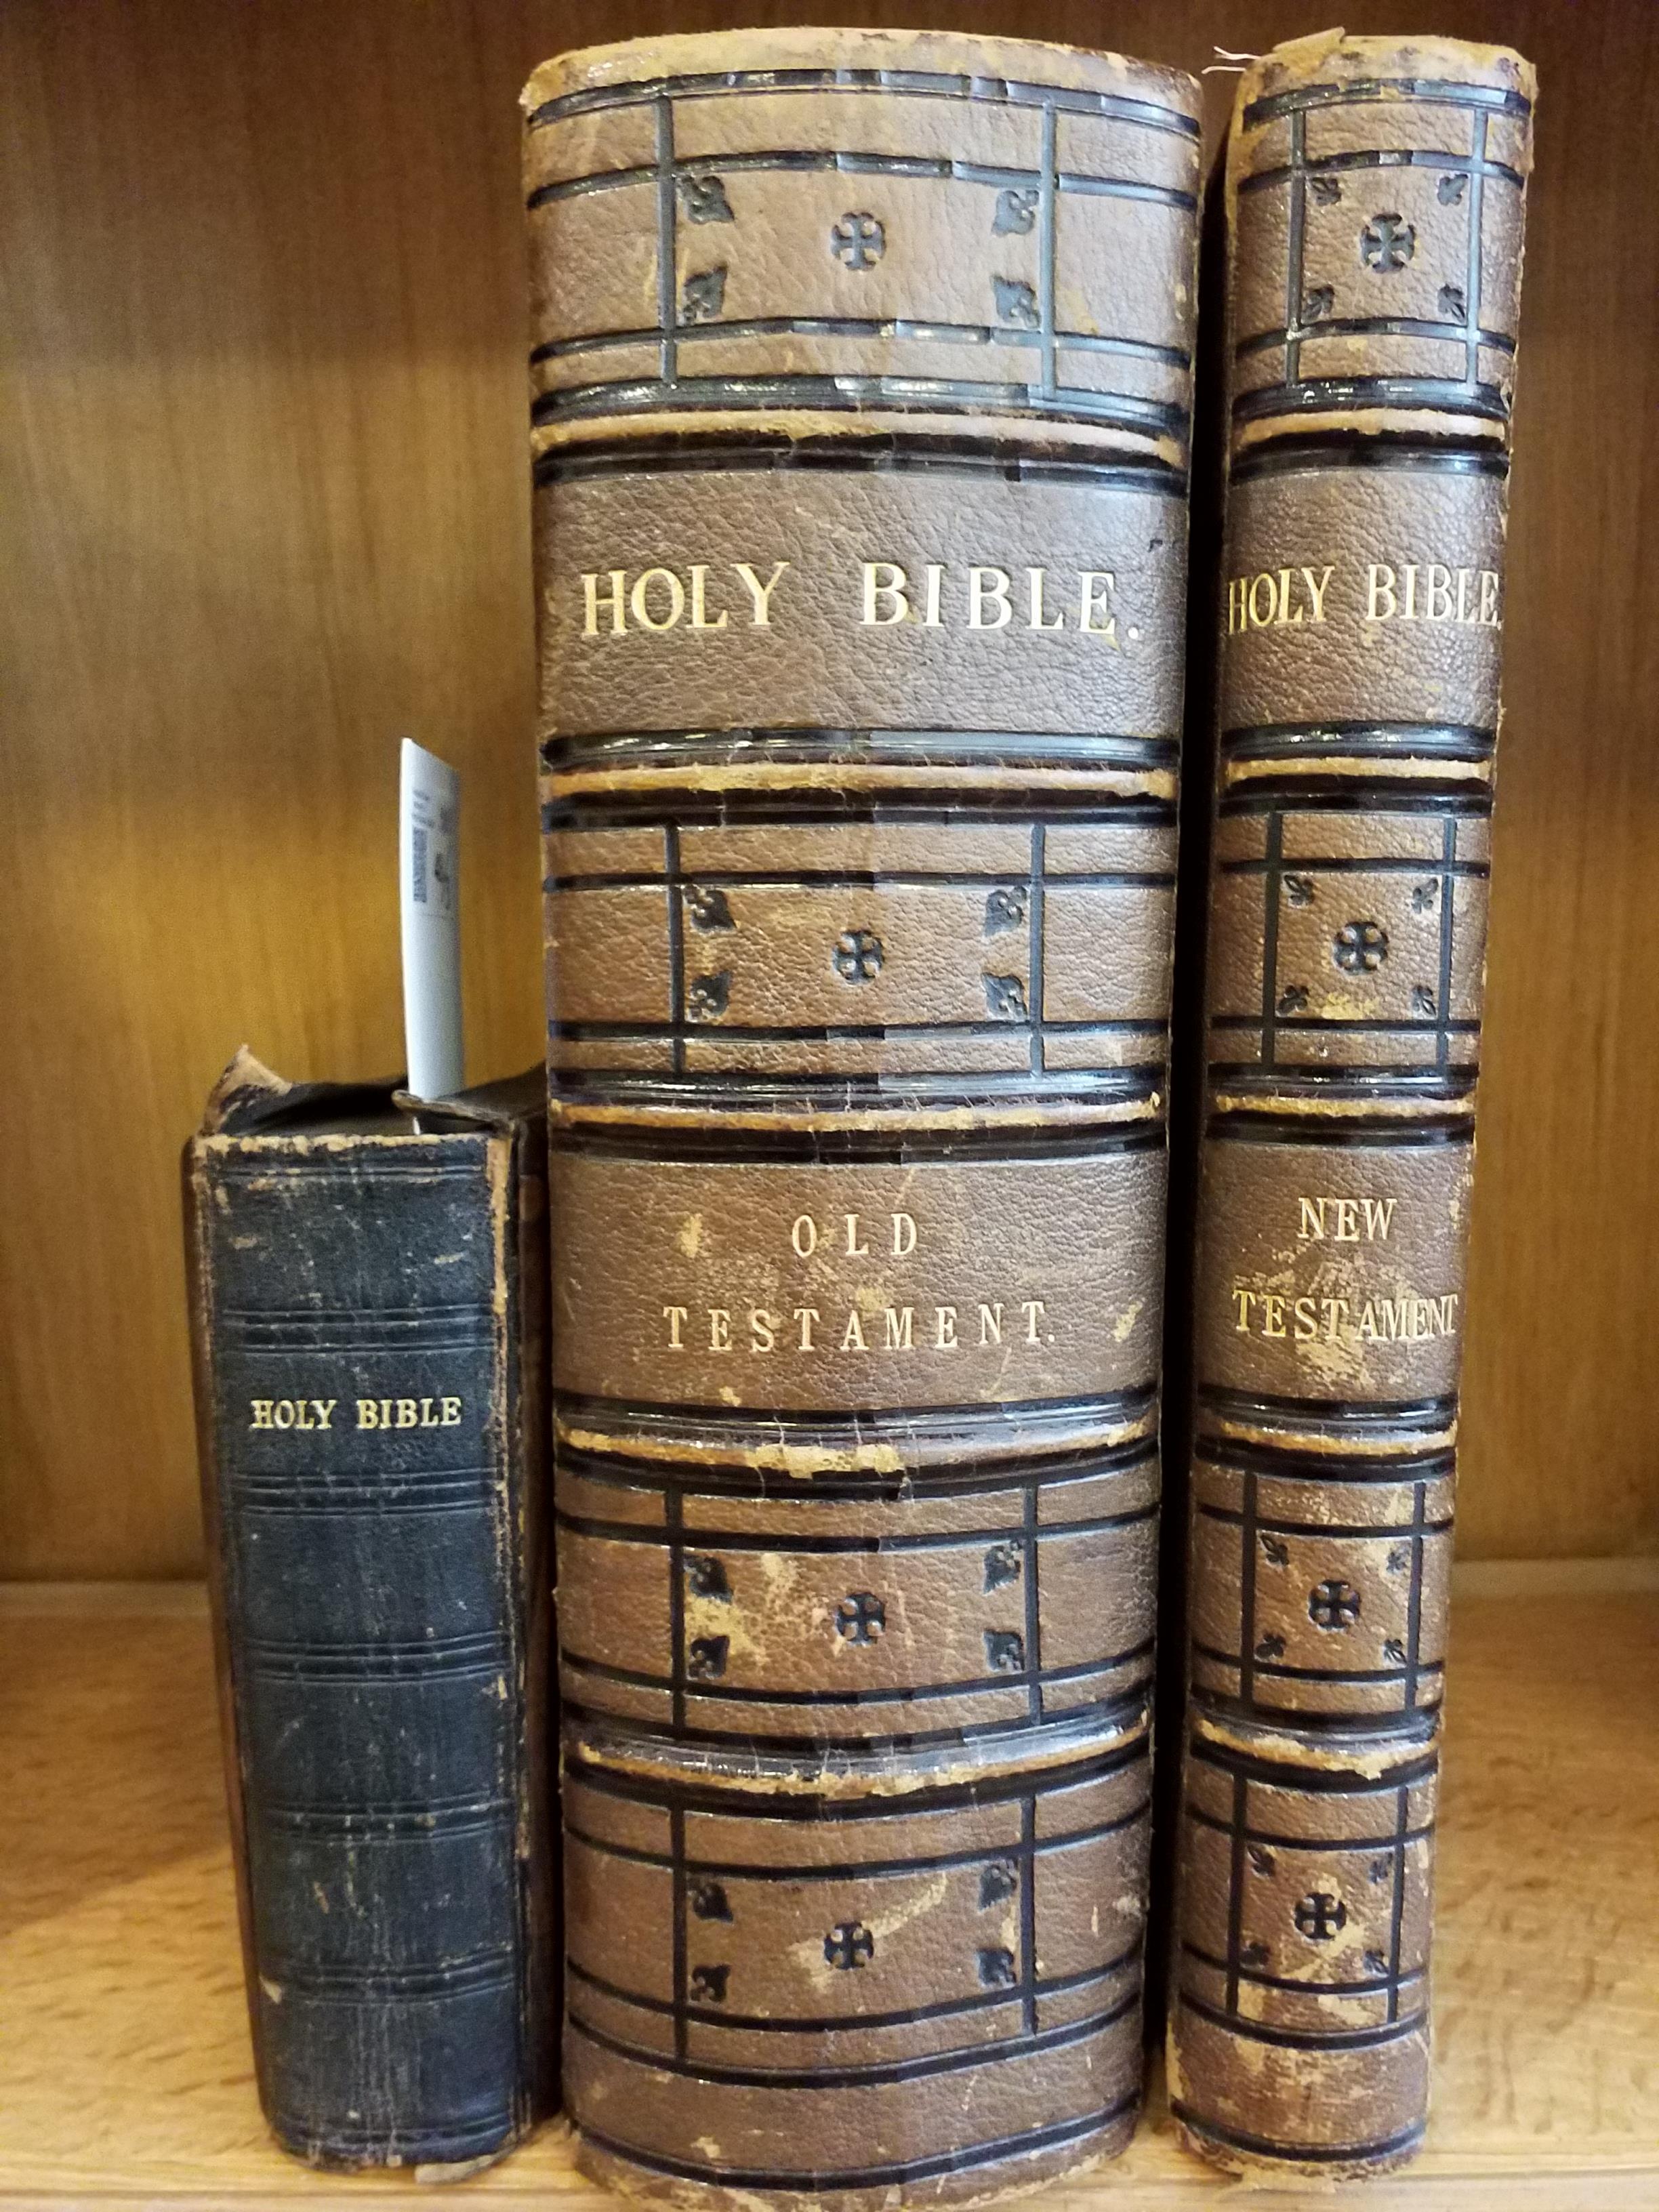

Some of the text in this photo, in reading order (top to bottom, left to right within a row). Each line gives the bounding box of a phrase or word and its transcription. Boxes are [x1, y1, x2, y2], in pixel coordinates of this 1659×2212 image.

[581, 561, 1139, 640] HOLY BIBLE.
[1228, 565, 1335, 635] HOLY
[792, 1212, 917, 1258] OLD
[1297, 1197, 1397, 1242] NEW
[663, 1300, 1056, 1353] TESTAMENT.
[1232, 1289, 1458, 1341] TESTAMENT
[249, 1397, 462, 1430] HOLY BIBLE
